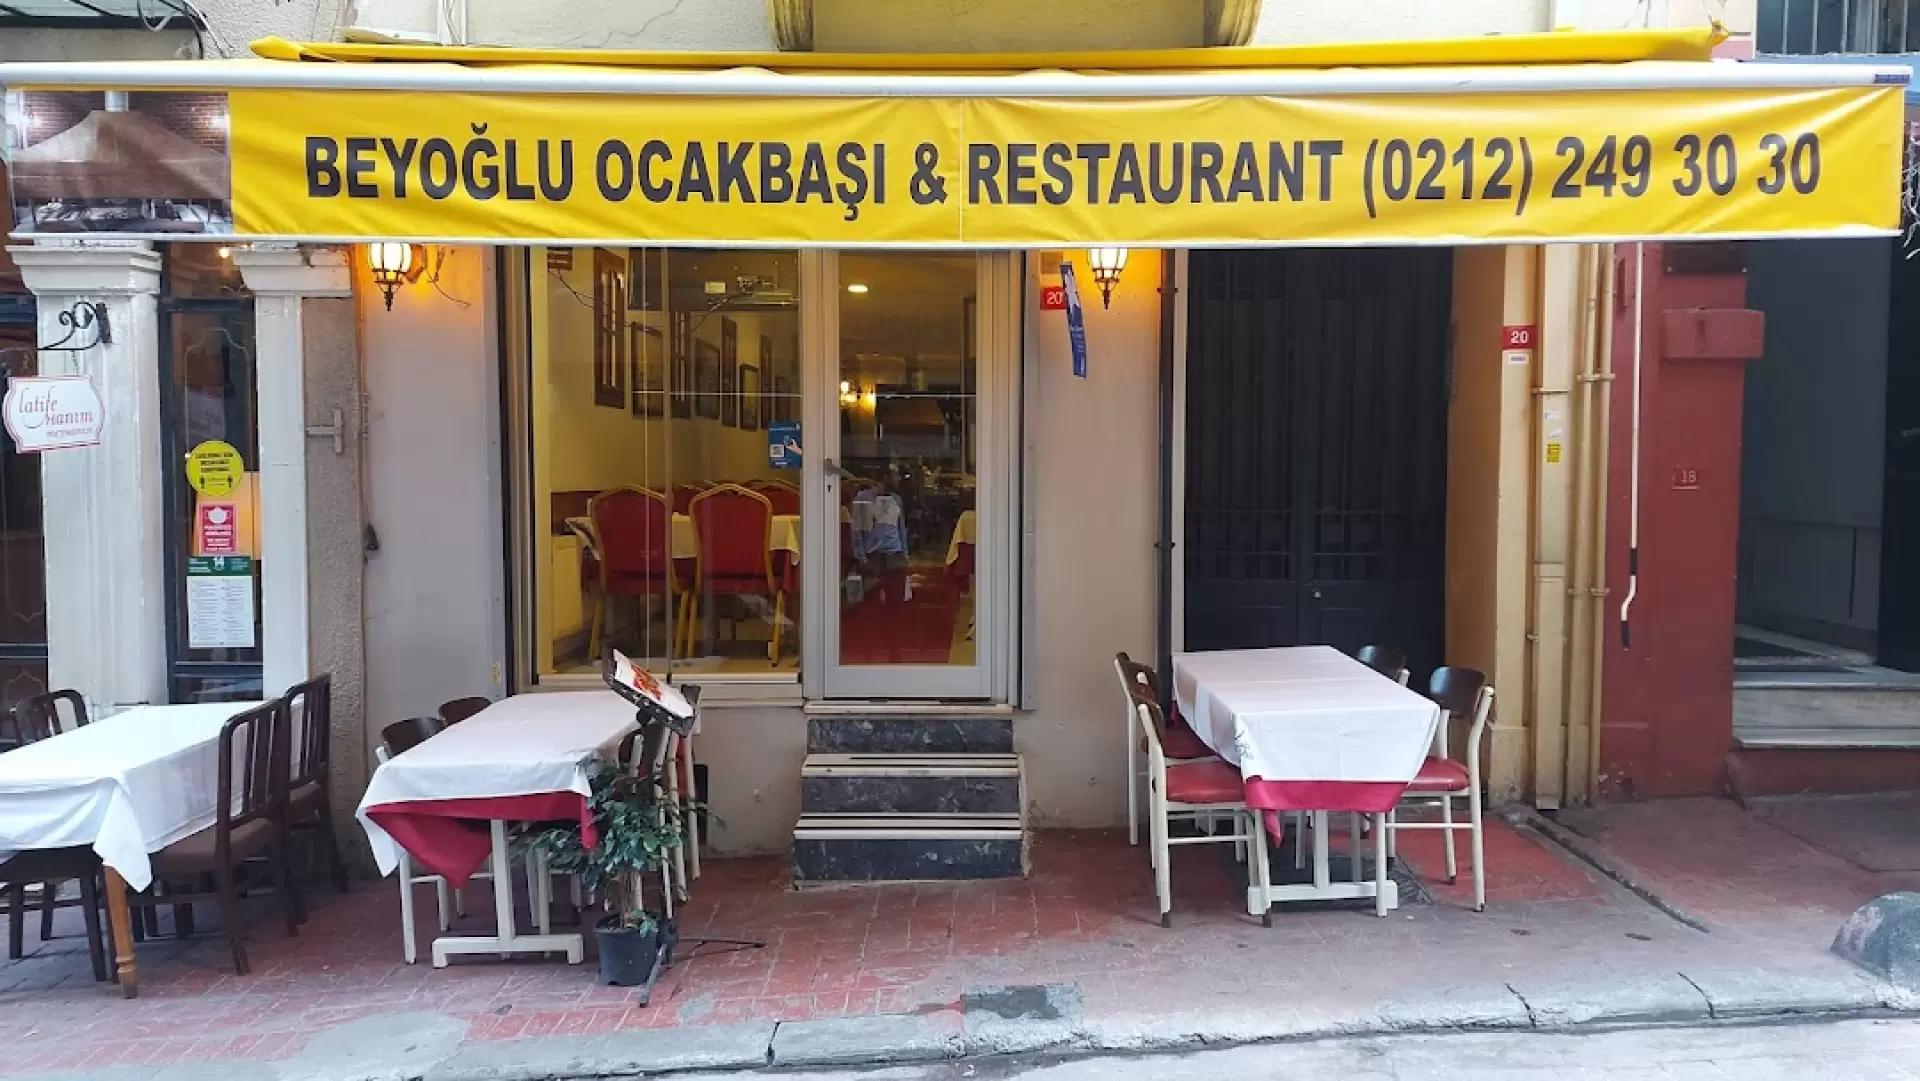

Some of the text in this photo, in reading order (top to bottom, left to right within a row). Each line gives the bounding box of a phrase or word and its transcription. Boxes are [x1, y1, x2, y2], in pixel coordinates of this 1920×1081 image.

[305, 121, 1820, 222] BEYOĞLU OCAKBAŞI & RESTAURANT (0212) 249 30 30
[1046, 291, 1064, 305] 20
[1509, 329, 1530, 344] 20
[1681, 470, 1697, 483] 18
